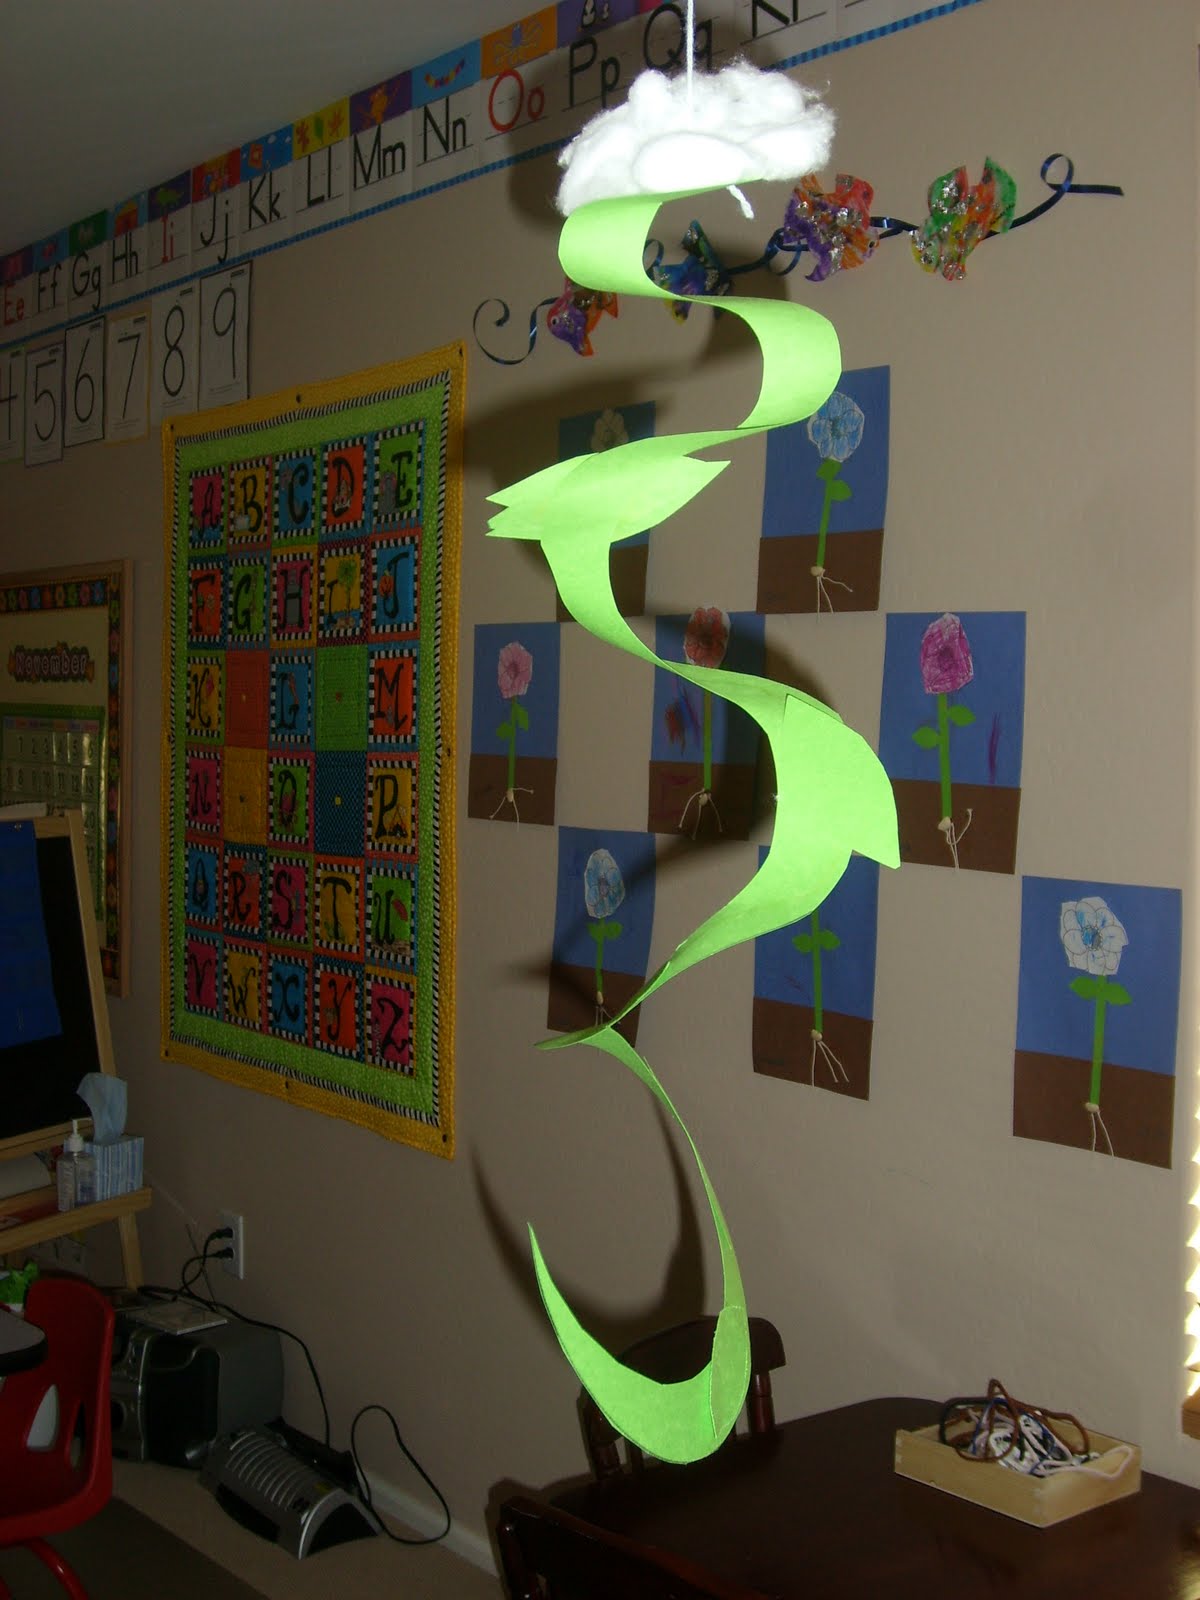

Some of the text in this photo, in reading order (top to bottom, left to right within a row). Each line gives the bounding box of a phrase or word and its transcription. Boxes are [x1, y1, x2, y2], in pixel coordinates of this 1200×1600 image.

[3, 283, 24, 325] Ee
[38, 263, 61, 312] Ff
[72, 252, 101, 312] Gg
[112, 233, 139, 284] Hh
[160, 215, 174, 263] Ii
[200, 194, 230, 264] Jj
[248, 172, 281, 230] Kk
[306, 146, 331, 206] Ll
[353, 121, 404, 190] Mm
[424, 97, 465, 162] Nn
[489, 69, 545, 132] Oo
[567, 37, 621, 108] Pp
[34, 359, 56, 441] 5
[74, 337, 95, 423] 6
[118, 333, 141, 420] 7
[162, 305, 186, 397] 8
[213, 287, 237, 380] 9
[240, 474, 264, 532] B
[289, 462, 309, 525] C
[332, 456, 355, 518] D
[391, 450, 413, 508] E
[233, 573, 252, 631] G
[280, 564, 310, 630] H
[383, 551, 410, 620] J
[15, 651, 87, 676] November
[190, 668, 212, 728] K
[376, 663, 409, 732] M
[375, 774, 398, 840] P
[229, 871, 252, 921] R
[274, 869, 293, 930] S
[323, 876, 353, 940] T
[227, 967, 256, 1018] W
[272, 972, 301, 1024] X
